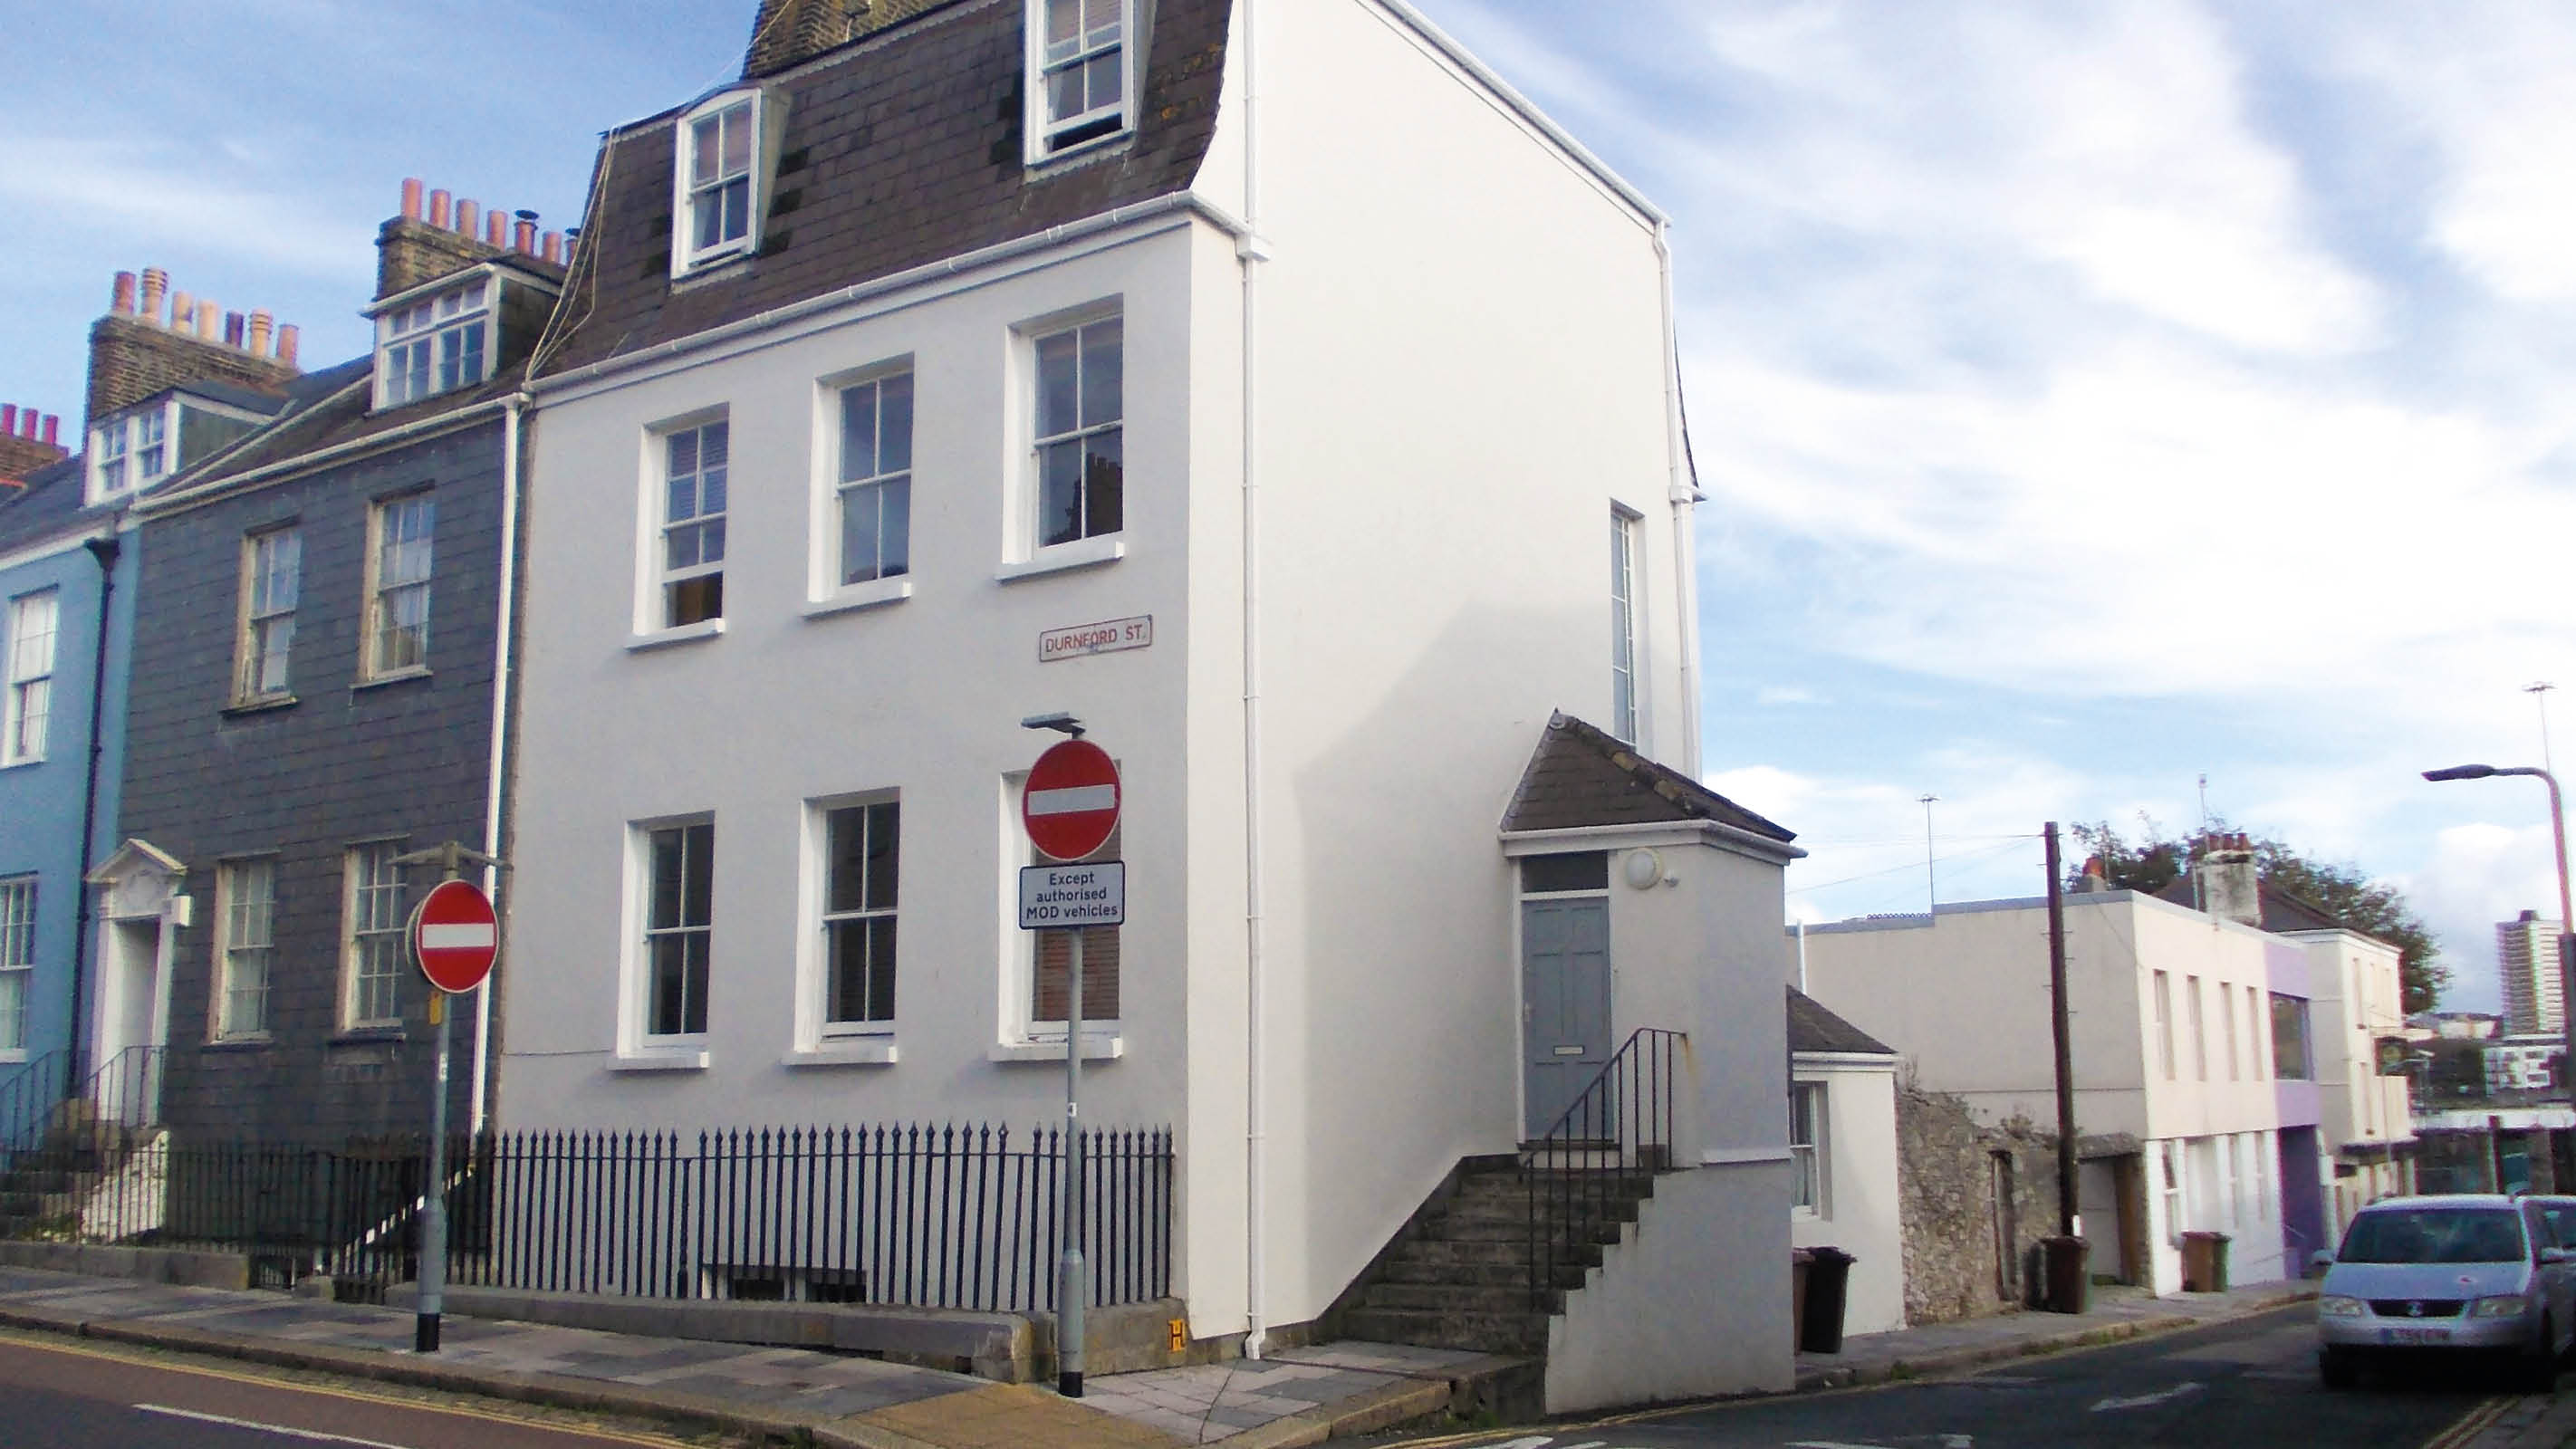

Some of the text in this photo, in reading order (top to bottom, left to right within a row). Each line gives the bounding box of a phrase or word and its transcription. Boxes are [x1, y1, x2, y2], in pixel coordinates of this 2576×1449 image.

[1045, 629, 1118, 653] DURNFORD
[1049, 871, 1095, 886] Except
[1036, 887, 1107, 902] authorised
[1026, 904, 1119, 920] MOD vehicles
[1169, 1321, 1186, 1351] H
